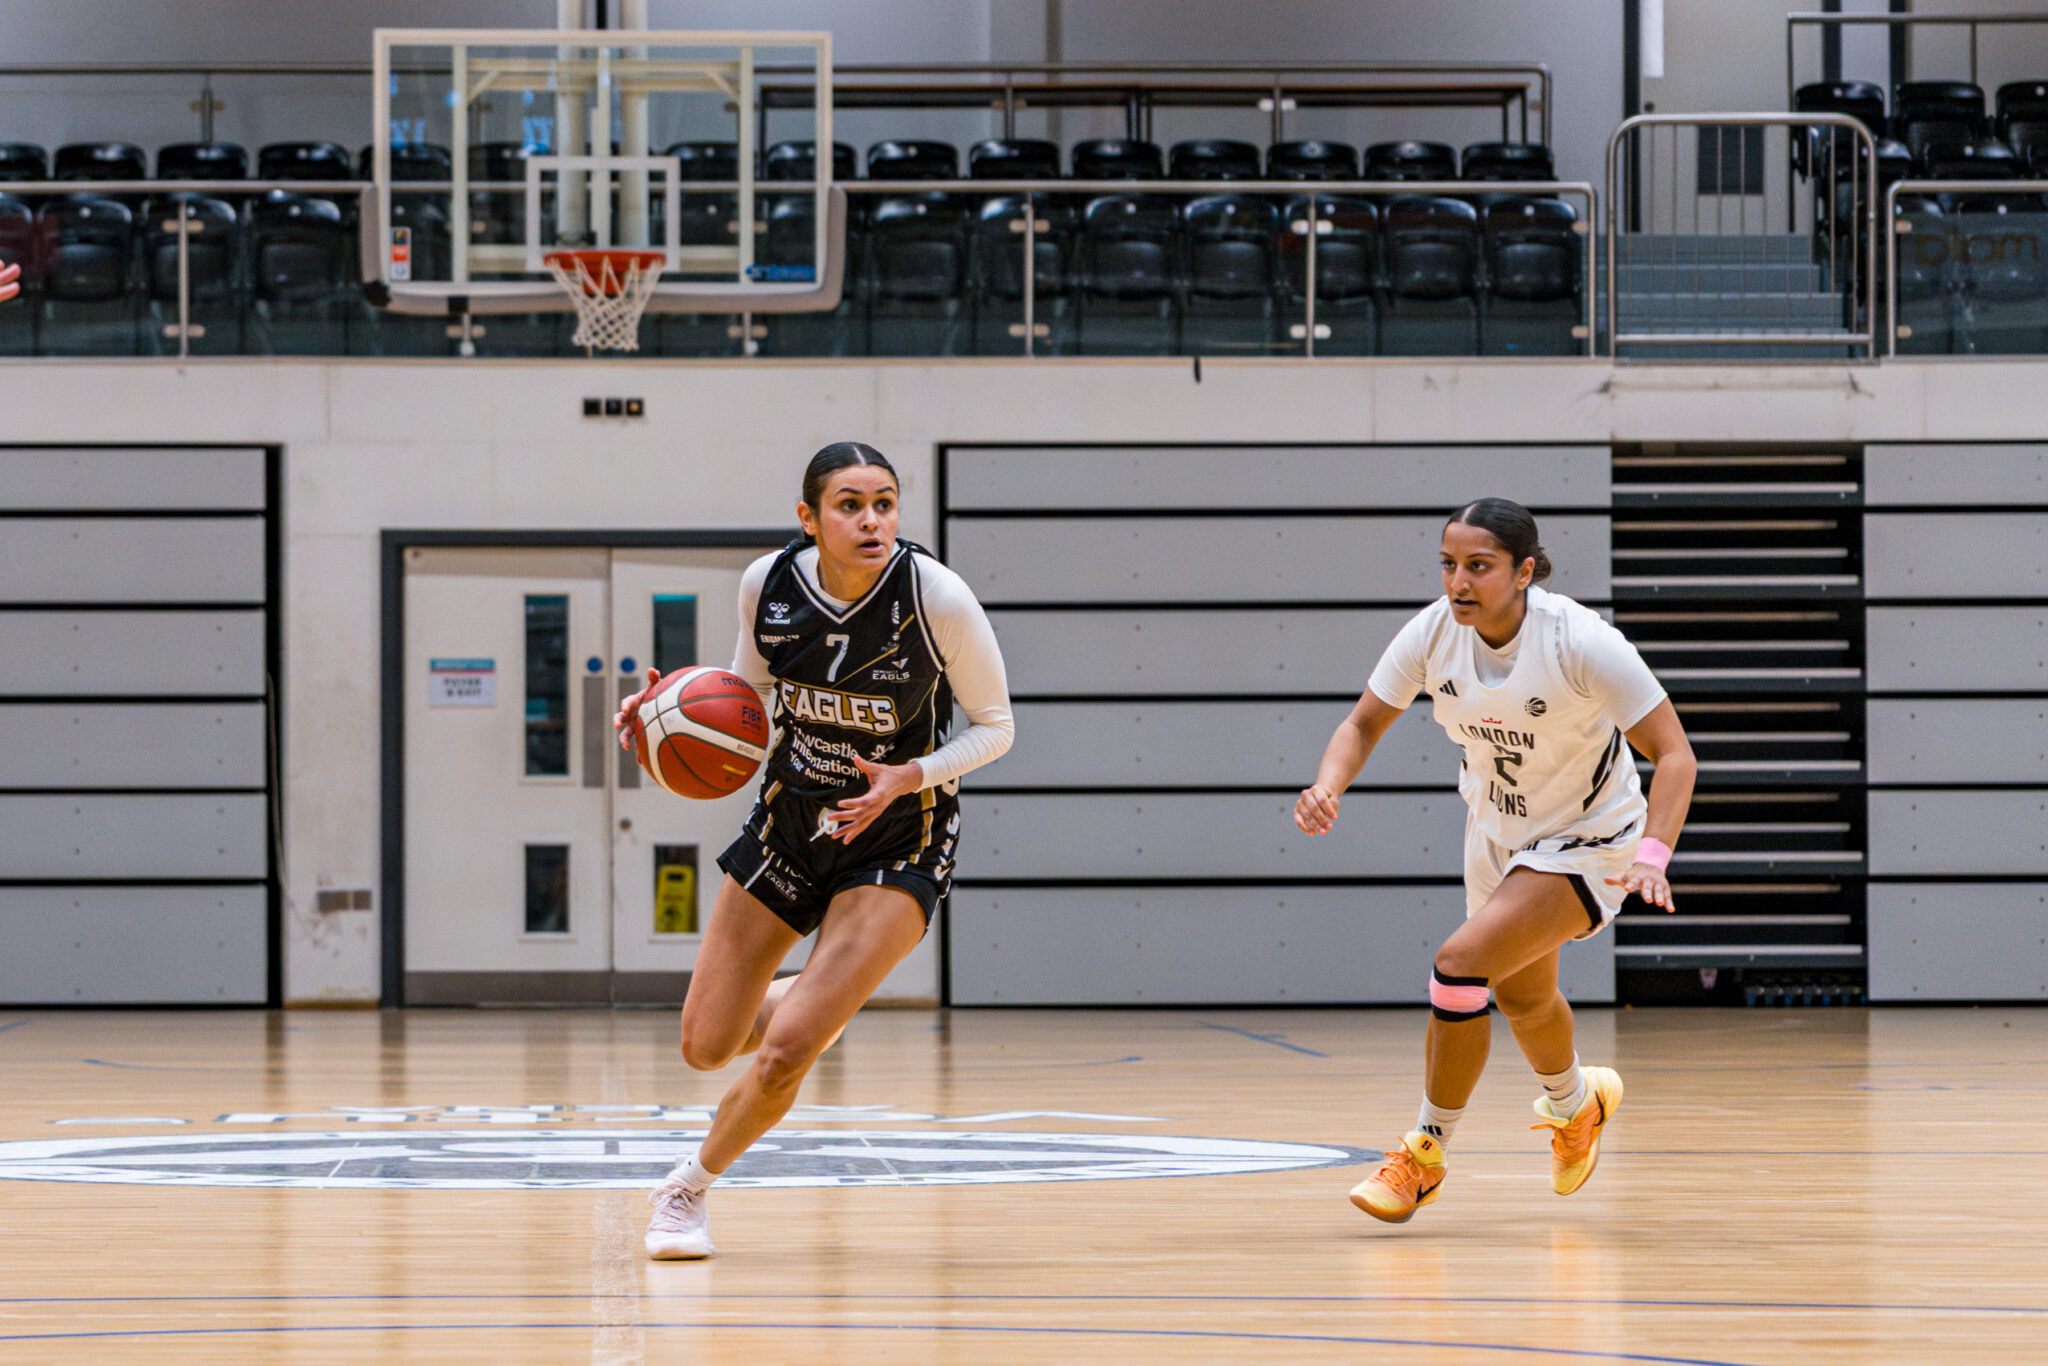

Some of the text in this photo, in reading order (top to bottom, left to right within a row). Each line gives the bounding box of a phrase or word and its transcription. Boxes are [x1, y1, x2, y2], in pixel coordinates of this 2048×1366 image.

[826, 633, 850, 682] 7
[781, 679, 897, 734] EAGLES
[793, 726, 860, 760] wcastle
[1459, 723, 1535, 750] LONDON
[805, 767, 847, 788] Airport
[1493, 744, 1523, 787] 2
